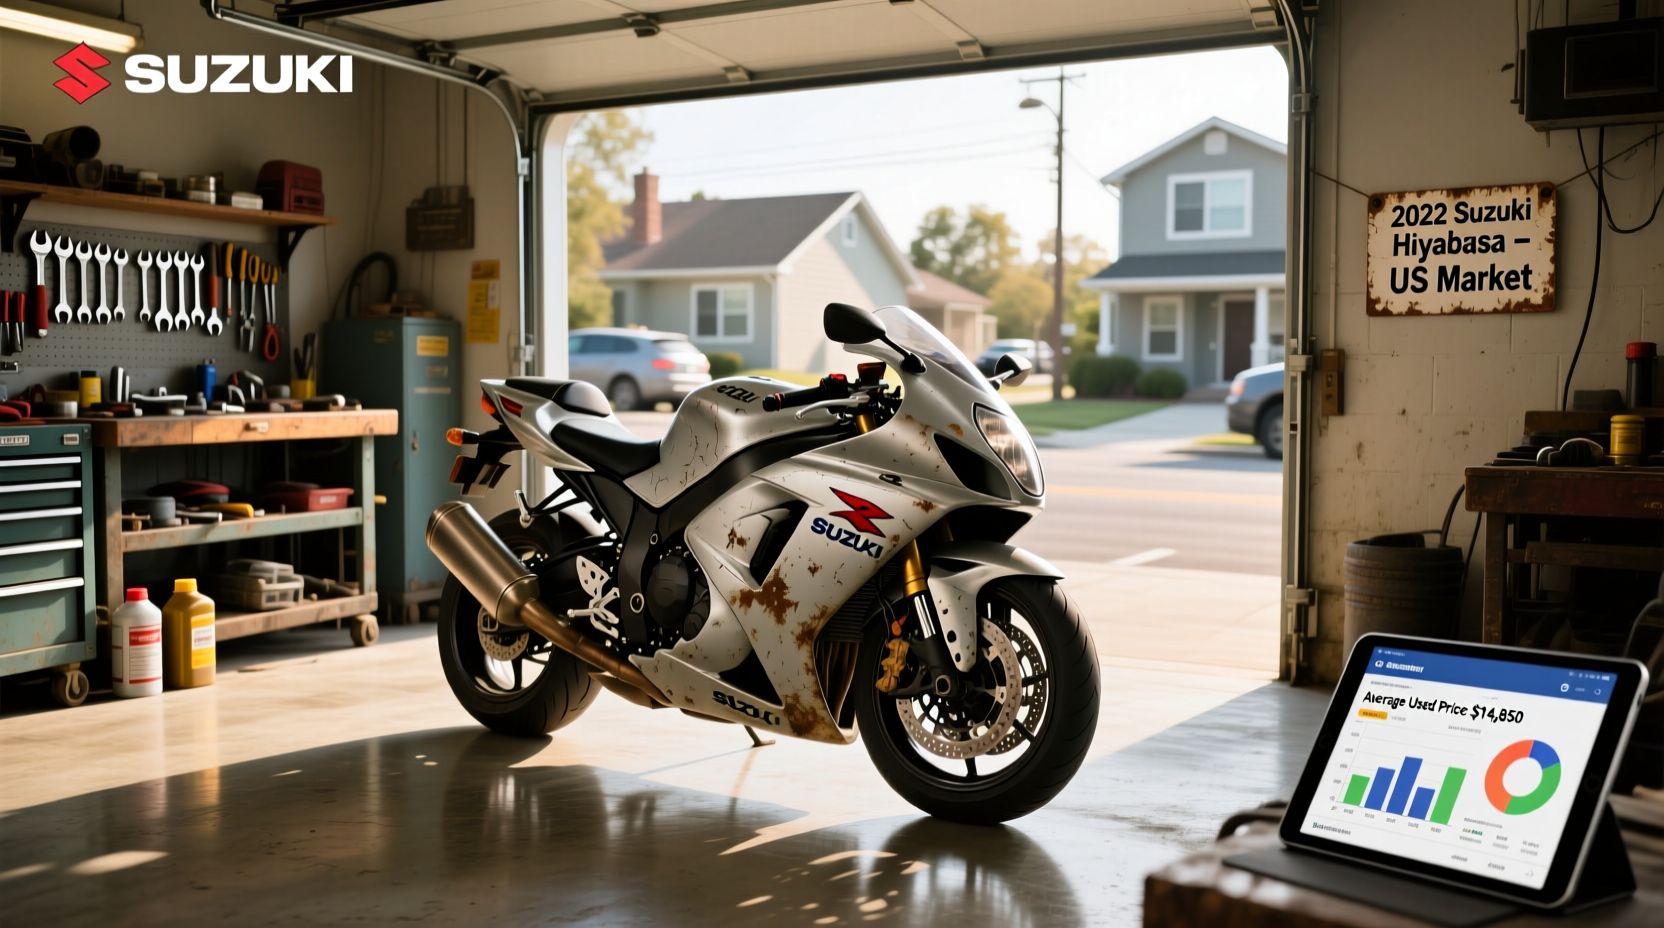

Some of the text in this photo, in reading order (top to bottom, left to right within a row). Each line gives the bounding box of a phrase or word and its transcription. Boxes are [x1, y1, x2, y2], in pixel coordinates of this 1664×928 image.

[1390, 197, 1532, 228] 2022 Suzuki
[1392, 230, 1506, 264] Hiyabasa
[1390, 263, 1533, 294] US Market
[810, 516, 885, 559] SUZUKI
[1408, 695, 1438, 712] Used
[1437, 700, 1469, 717] Price
[1469, 703, 1525, 724] $14,850
